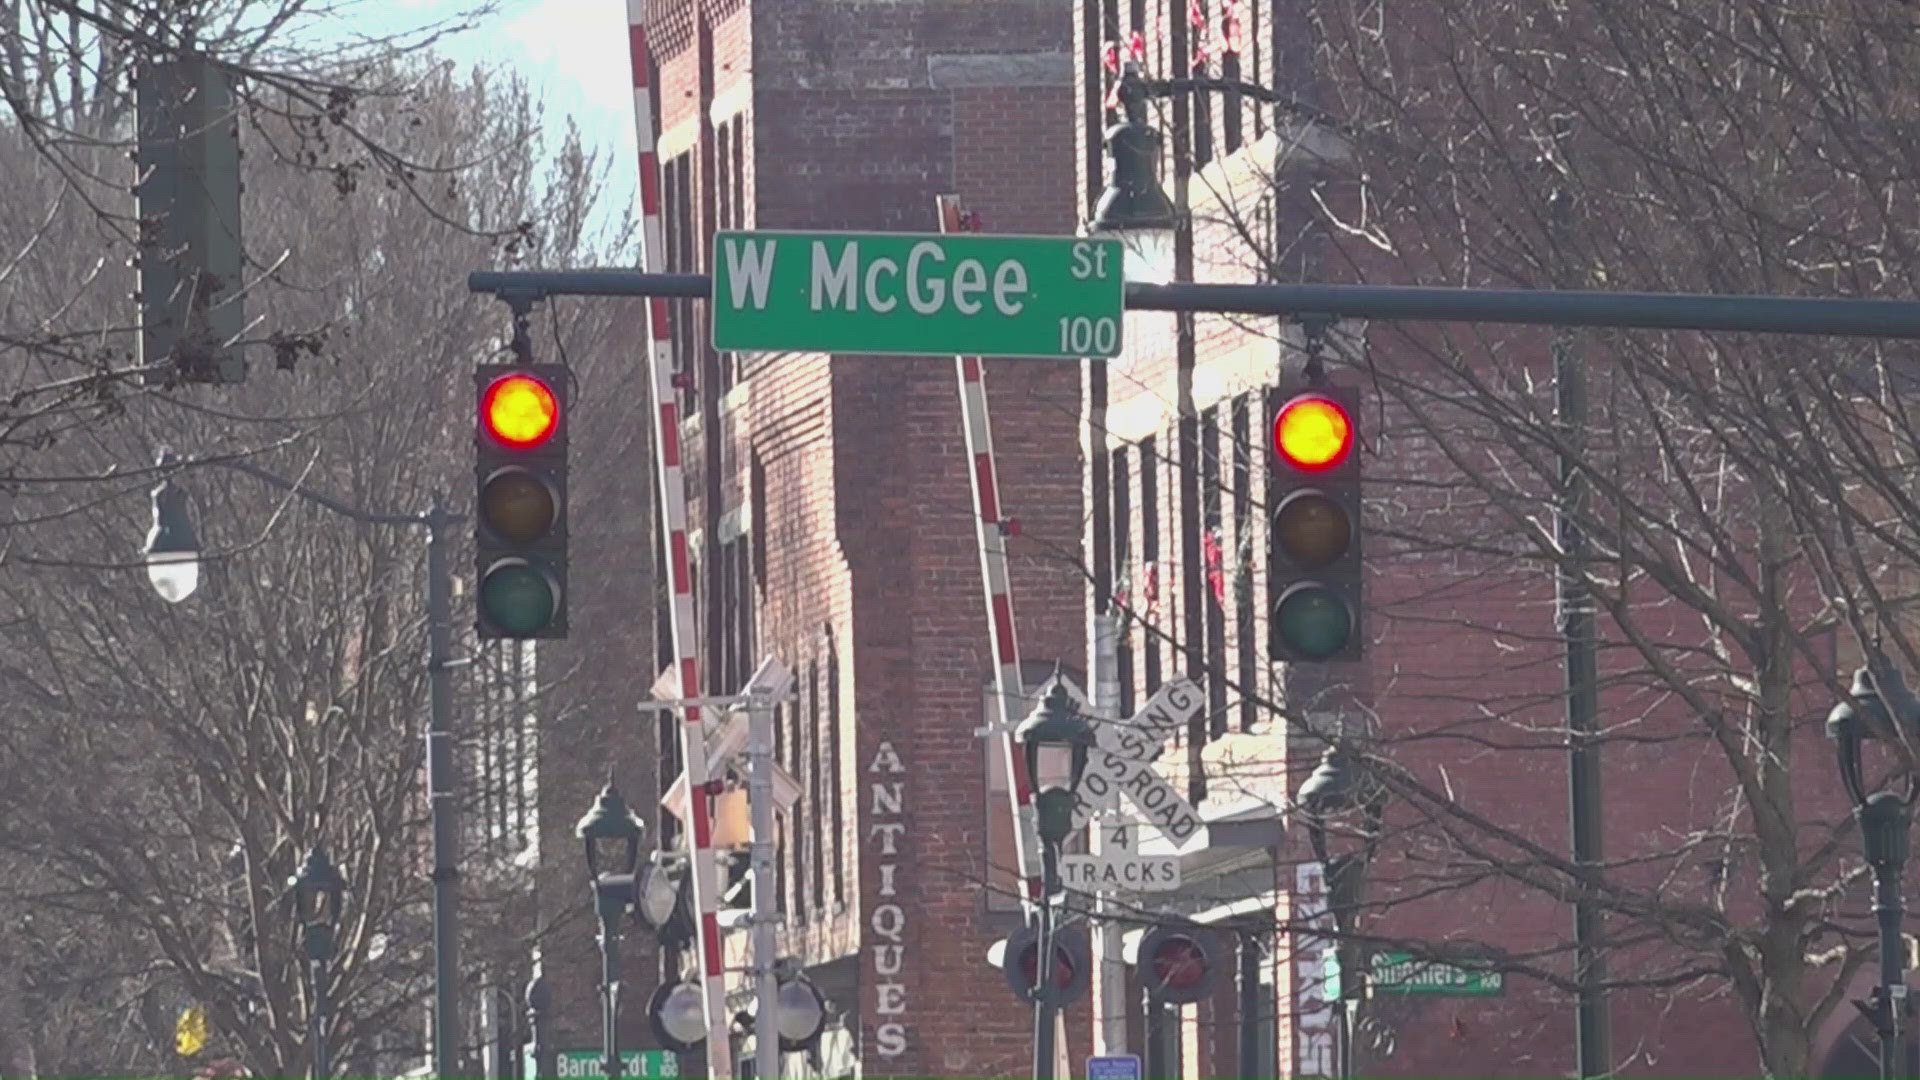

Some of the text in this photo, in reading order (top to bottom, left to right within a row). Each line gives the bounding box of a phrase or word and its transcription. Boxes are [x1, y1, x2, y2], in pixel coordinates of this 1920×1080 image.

[724, 239, 1027, 314] W McGee
[1071, 241, 1107, 279] St
[1058, 316, 1117, 353] 100
[1071, 686, 1191, 818] ROSSING
[1111, 825, 1128, 849] 4
[1065, 861, 1175, 883] TRACKS
[868, 741, 907, 1056] ANTIQUES
